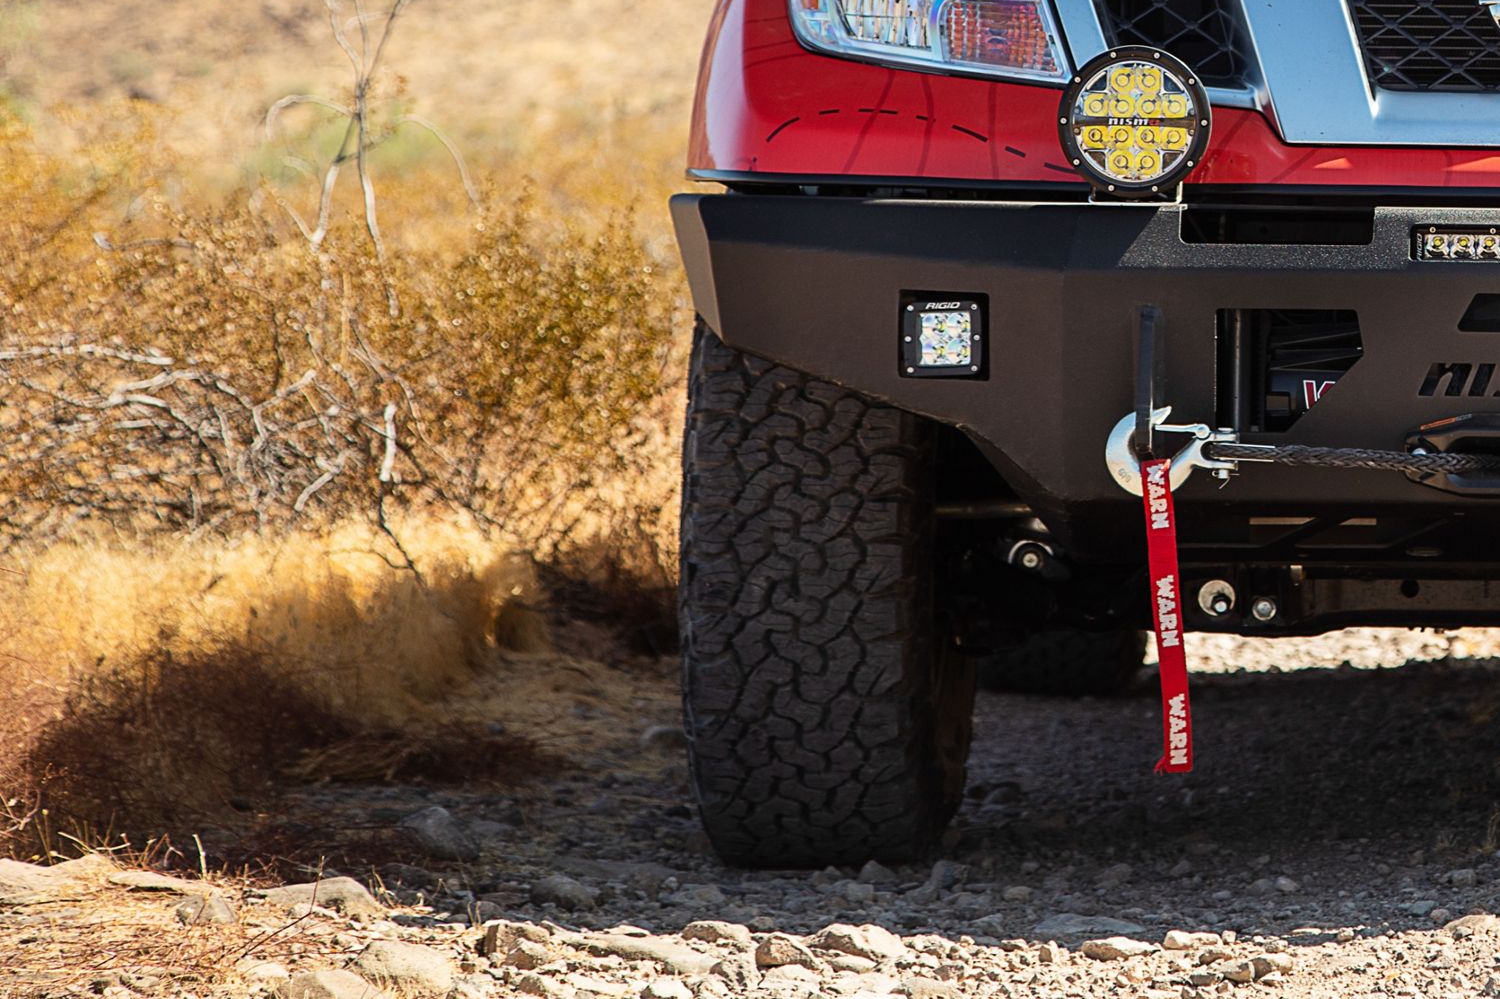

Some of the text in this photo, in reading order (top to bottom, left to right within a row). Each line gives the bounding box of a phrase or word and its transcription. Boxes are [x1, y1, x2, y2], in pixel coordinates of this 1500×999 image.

[1108, 117, 1161, 126] nismo
[925, 302, 961, 310] RIGID
[1146, 463, 1170, 530] WARN
[1156, 574, 1180, 648] WARN
[1167, 693, 1188, 765] WARN
